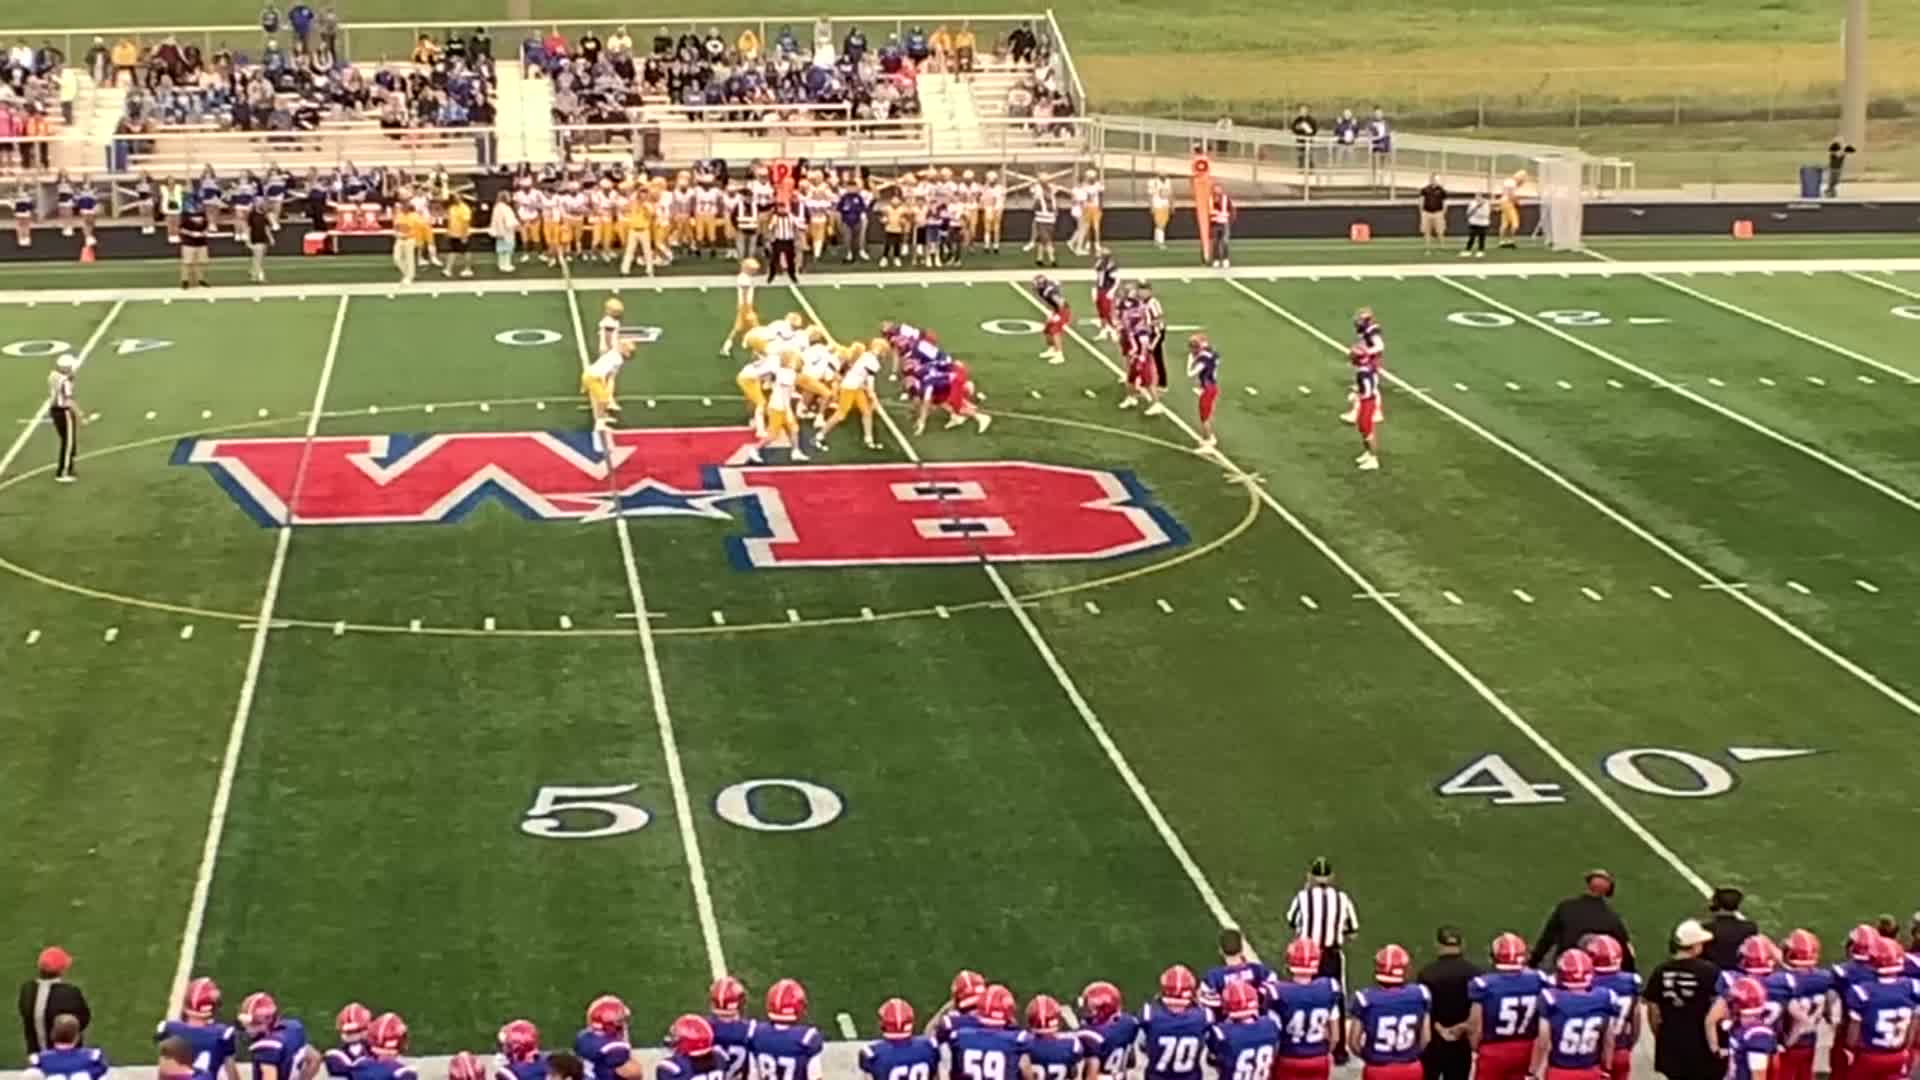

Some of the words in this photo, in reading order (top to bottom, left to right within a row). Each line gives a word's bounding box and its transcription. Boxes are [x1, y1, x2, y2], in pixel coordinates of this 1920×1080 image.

[1286, 1007, 1329, 1043] 48
[1374, 1014, 1418, 1051] 56
[1495, 995, 1537, 1036] 57
[1559, 1016, 1601, 1054] 66
[963, 1048, 1006, 1080] 59
[1155, 1036, 1199, 1072] 70
